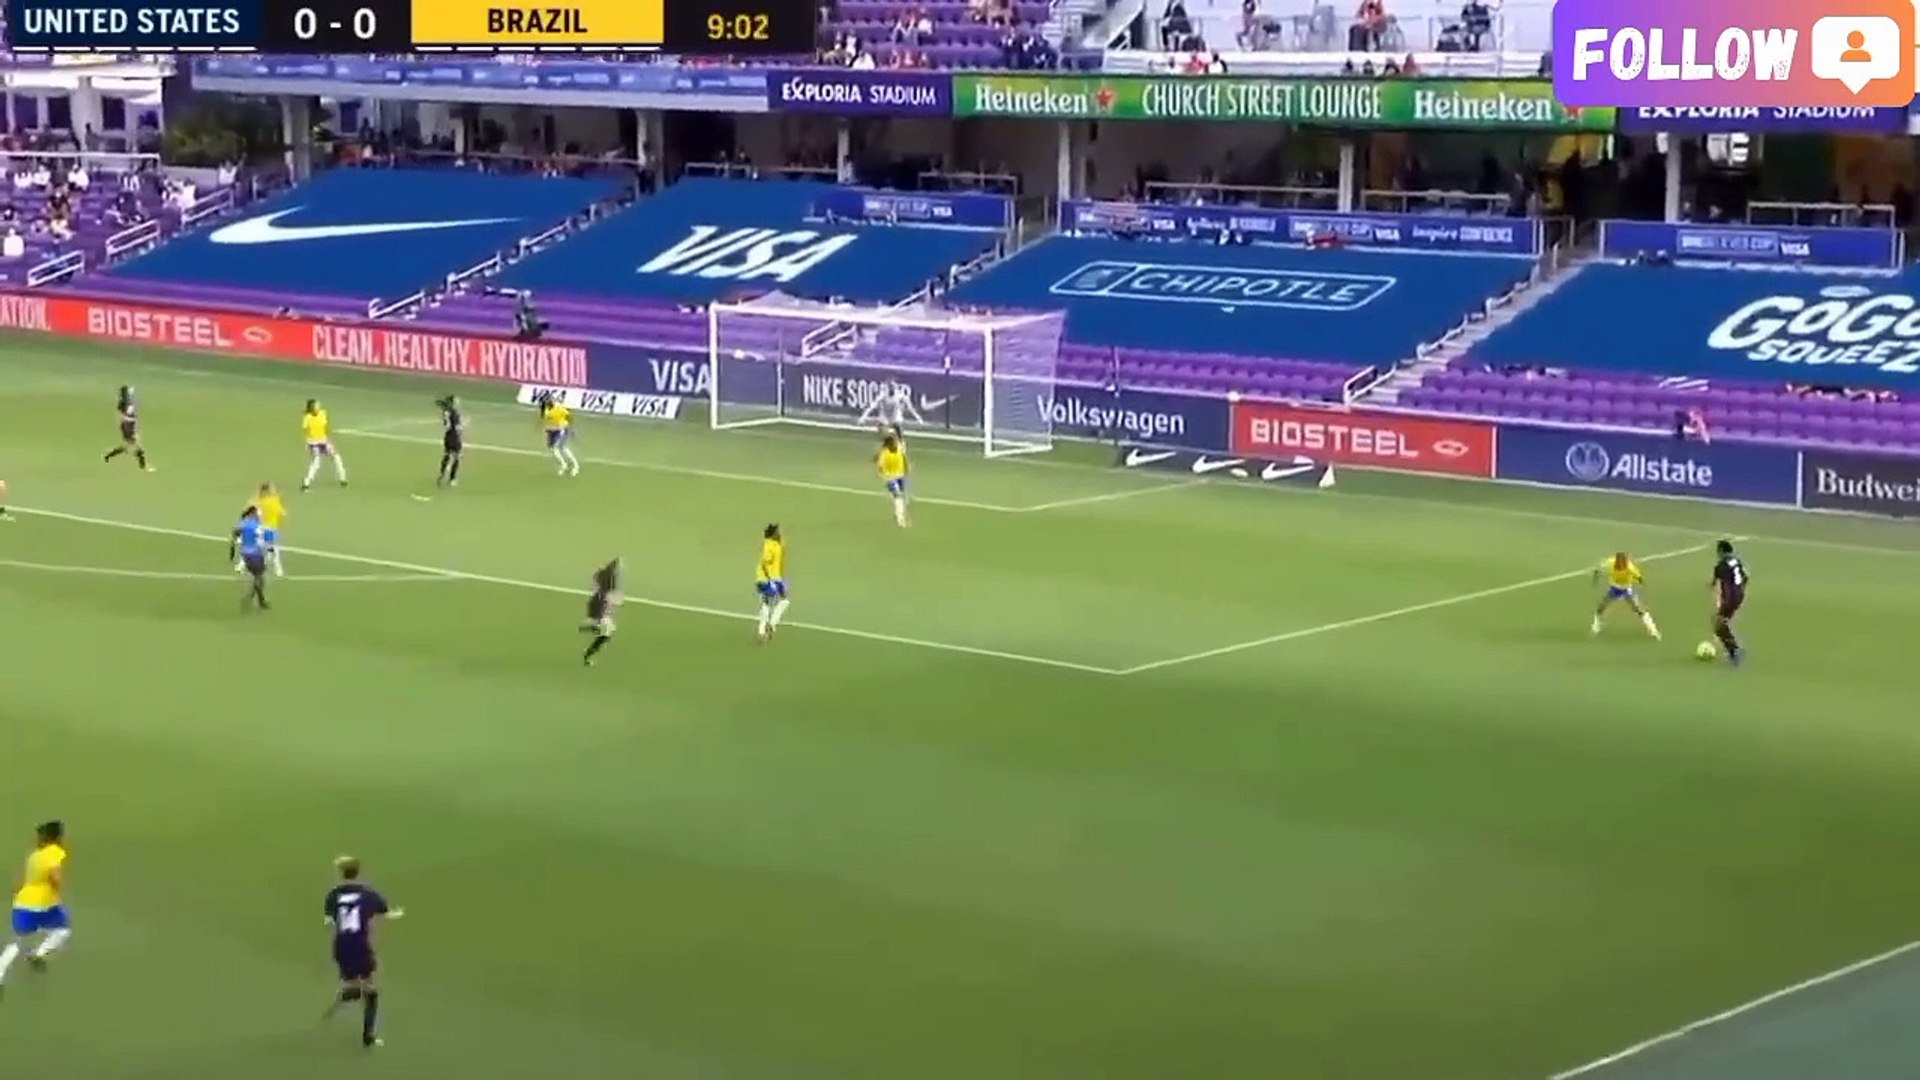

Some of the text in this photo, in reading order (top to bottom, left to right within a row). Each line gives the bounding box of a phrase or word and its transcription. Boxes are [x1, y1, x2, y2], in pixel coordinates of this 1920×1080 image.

[782, 77, 936, 106] EXPLORIA STADIUM
[975, 83, 1087, 114] Heineken
[1142, 83, 1382, 120] CHURCH STREET LOUNGE
[1414, 90, 1552, 121] Heineken
[636, 225, 859, 282] VISA
[1780, 243, 1810, 255] VISA
[1130, 272, 1370, 301] CHIPOTLE
[87, 307, 236, 347] BIOSTEEL
[312, 324, 379, 365] CLEAN.
[385, 331, 476, 375] HEALTHY.
[648, 358, 712, 393] VISA
[803, 374, 843, 406] NIKE
[580, 391, 617, 414] VISA
[631, 396, 669, 416] VISA
[1037, 394, 1185, 435] Volkswagen
[1250, 417, 1420, 458] BIOSTEEL
[1609, 453, 1713, 487] Allstate
